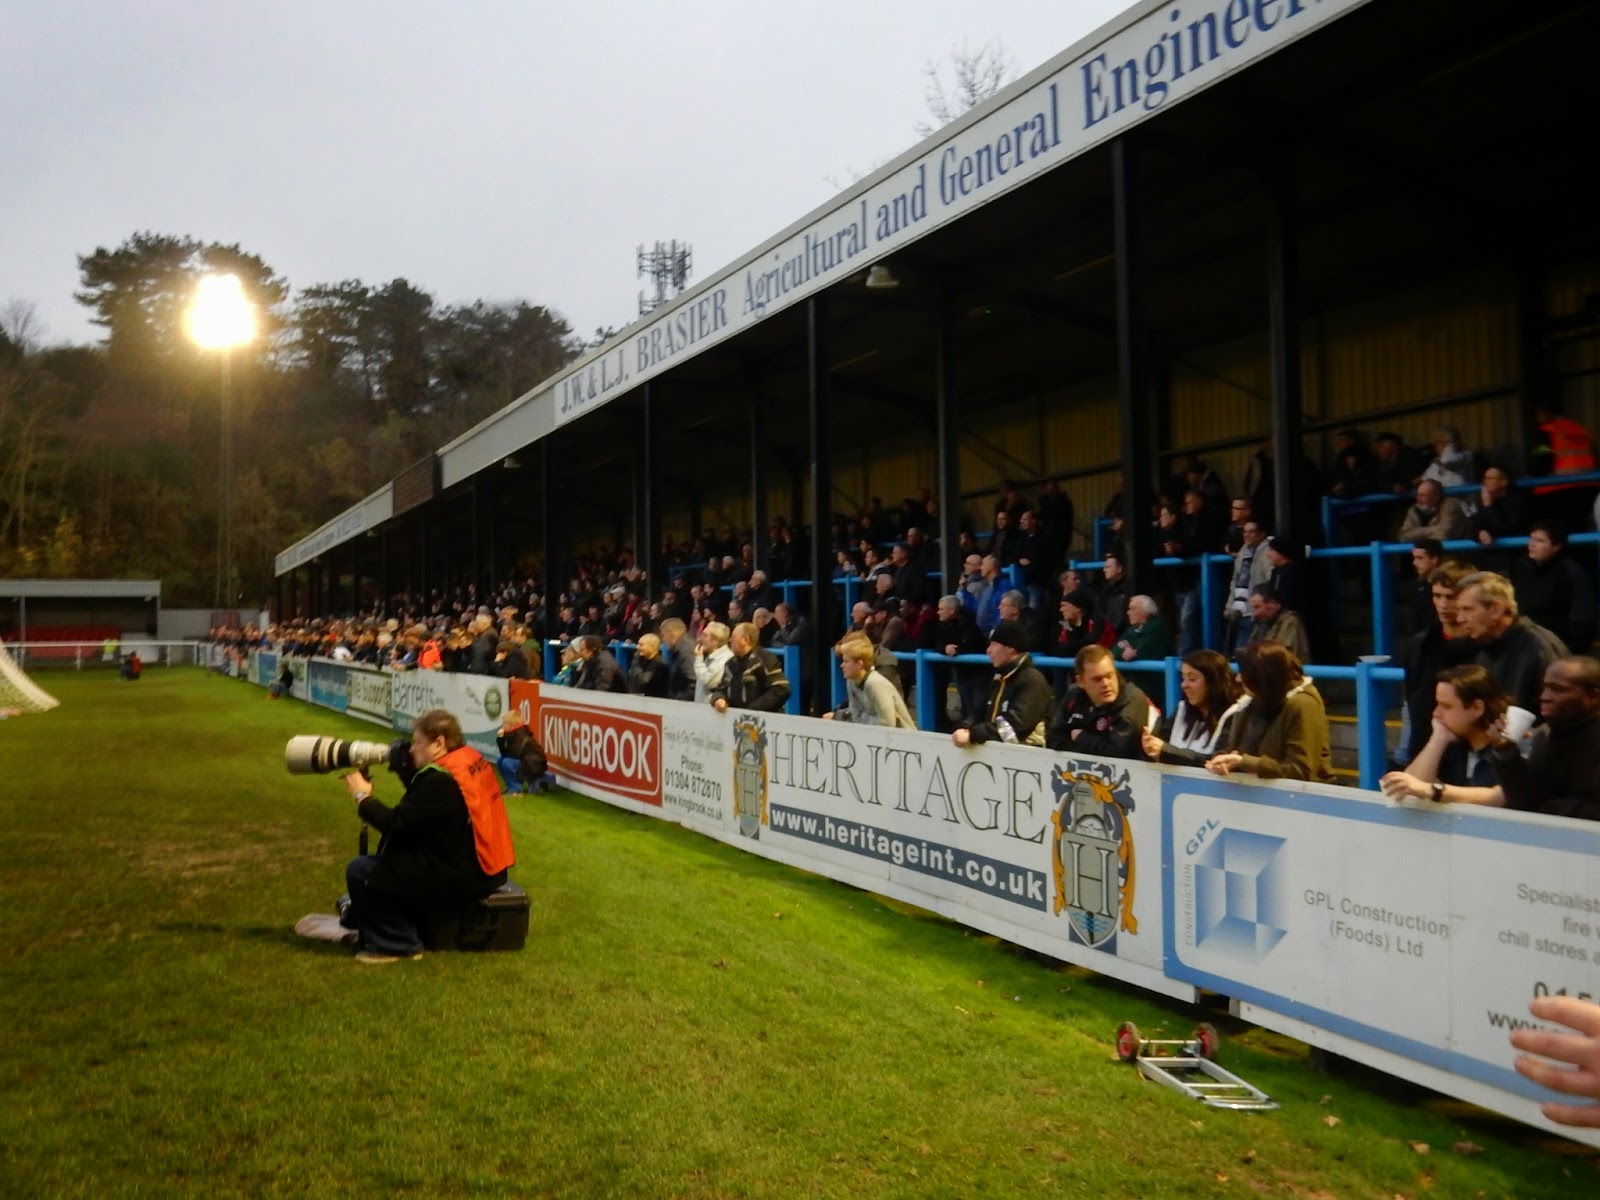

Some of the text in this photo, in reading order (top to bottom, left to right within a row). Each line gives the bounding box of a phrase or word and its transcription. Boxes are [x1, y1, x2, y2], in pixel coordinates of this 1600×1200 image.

[637, 289, 729, 374] BRASIER
[741, 200, 868, 320] Agricultural
[876, 164, 929, 242] and
[939, 82, 1062, 206] General
[1081, 0, 1321, 130] Enginee
[544, 714, 653, 783] KINGBROOK
[664, 768, 722, 802] 01304 872870
[770, 730, 1047, 844] HERITAGE
[771, 807, 1045, 902] www.heritageint.co.uk
[1185, 819, 1220, 856] GPL
[1183, 863, 1194, 947] CONSTRUCTION
[1303, 889, 1450, 938] GPL Construction
[1562, 915, 1591, 938] fire
[1329, 920, 1424, 959] (Foods) Ltd
[1498, 929, 1530, 948] chill
[1535, 938, 1588, 962] stores
